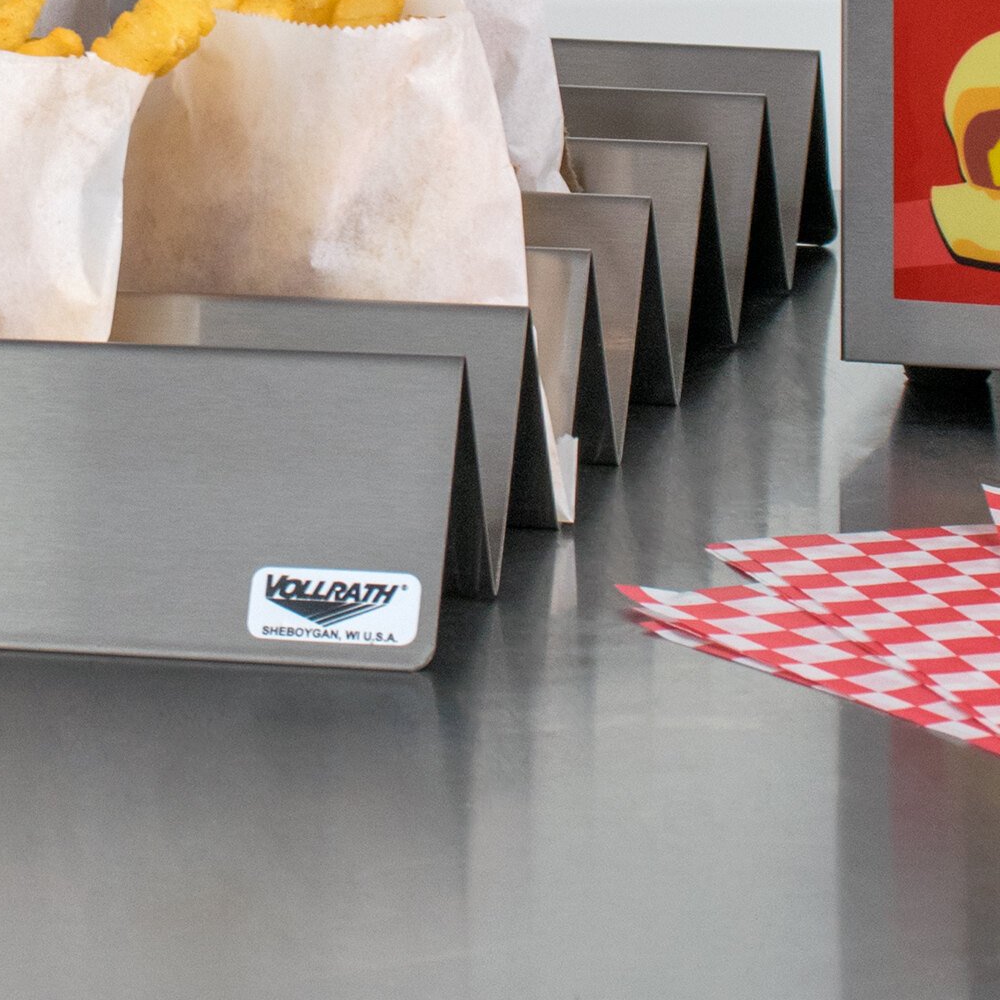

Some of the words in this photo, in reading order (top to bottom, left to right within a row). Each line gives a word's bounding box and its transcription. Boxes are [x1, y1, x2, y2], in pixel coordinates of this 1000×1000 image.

[265, 574, 398, 604] VOLLRATH
[262, 625, 341, 641] SHEBOYGAN,
[346, 631, 360, 641] WI
[363, 632, 398, 643] U.S.A.
